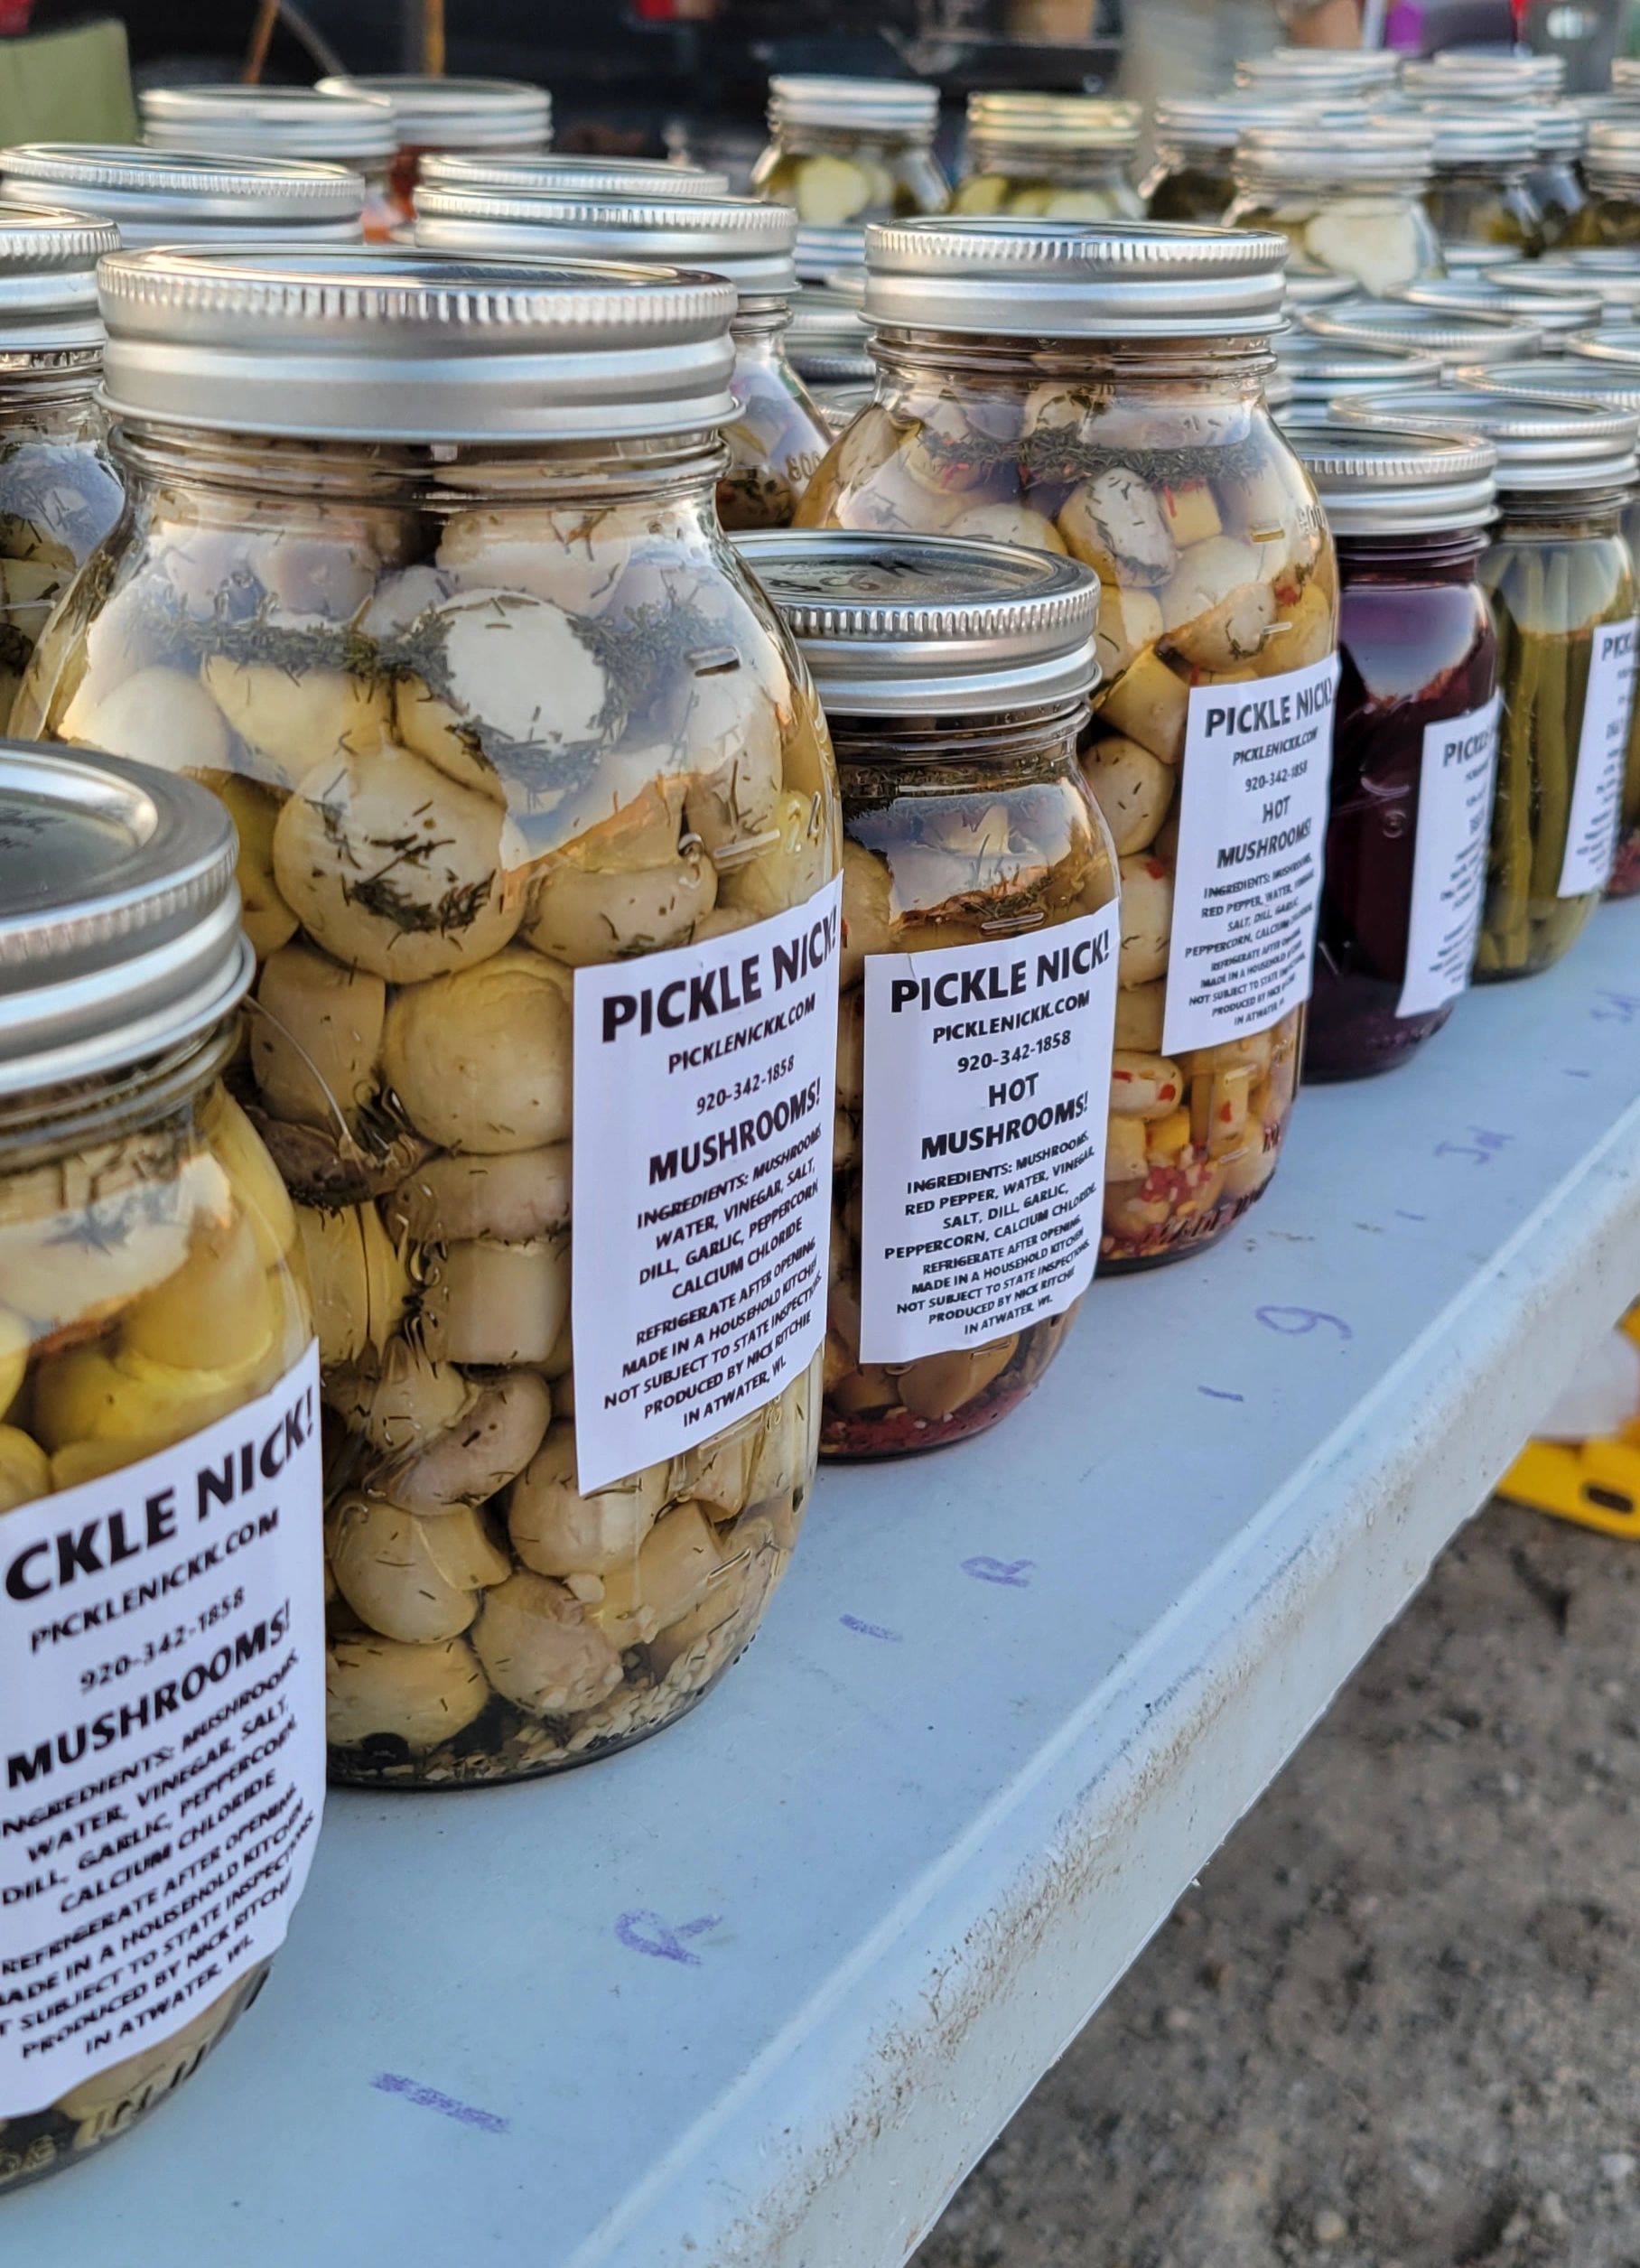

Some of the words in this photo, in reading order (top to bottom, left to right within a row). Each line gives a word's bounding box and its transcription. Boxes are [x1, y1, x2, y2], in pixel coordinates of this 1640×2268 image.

[1206, 695, 1291, 737] PICKLE
[1263, 795, 1291, 823] HOT
[1202, 906, 1224, 918] RED
[602, 955, 761, 1043] PICKLE
[772, 905, 836, 991] NICK!
[891, 961, 1026, 1013] PICKLE
[1037, 929, 1109, 987] NICK!
[1189, 994, 1210, 1005] NOT
[1213, 984, 1247, 1002] SUBJECT
[1249, 978, 1262, 990] TO
[1201, 975, 1225, 988] MADE
[1228, 971, 1238, 981] IN
[1240, 968, 1245, 978] A
[933, 990, 1089, 1043] PICKLENICKK.COM
[1212, 996, 1258, 1016] PRODUCED
[1235, 1015, 1244, 1025] IN
[669, 993, 815, 1074] PICKLENICKK.COM
[957, 1031, 1071, 1073] 920-342-1858
[697, 1055, 794, 1115] 920-342-1858
[989, 1072, 1039, 1107] HOT
[649, 1078, 820, 1185] MUSHROOMS!
[922, 1091, 1087, 1160] MUSHROOMS!
[638, 1173, 749, 1228] INGREDIENTS:
[657, 1215, 718, 1249] WATER,
[724, 1180, 783, 1222] VINEGAR,
[787, 1157, 815, 1186] SALT,
[905, 1200, 935, 1216] RED
[940, 1189, 998, 1209] PEPPER,
[1003, 1171, 1048, 1195] WATER,
[908, 1163, 1011, 1194] INGREDIENTS:
[943, 1212, 983, 1229] SALT,
[1023, 1183, 1068, 1208] GARLIC,
[640, 1259, 679, 1284] DILL,
[685, 1230, 744, 1265] GARLIC,
[672, 1256, 743, 1299] CALCIUM
[748, 1217, 802, 1265] CHLORIDE
[885, 1231, 989, 1259] PEPPERCORN,
[994, 1209, 1048, 1238] CALCIUM
[923, 1247, 1004, 1274] REFRIGERATE
[1007, 1235, 1038, 1255] AFTER
[637, 1293, 735, 1346] REFRIGERATE
[739, 1270, 771, 1303] AFTER
[774, 1237, 815, 1277] OPENING
[897, 1300, 926, 1314] NOT
[929, 1288, 983, 1308] SUBJECT
[985, 1283, 1001, 1295] TO
[1003, 1269, 1035, 1290] STATE
[912, 1277, 950, 1294] MADE
[955, 1274, 968, 1285] IN
[971, 1272, 980, 1282] A
[983, 1248, 1048, 1279] HOUSEHOLD
[929, 1301, 994, 1324] PRODUCED
[998, 1293, 1011, 1307] BY
[1015, 1283, 1039, 1301] NICK
[964, 1323, 978, 1334] IN
[622, 1346, 667, 1377] MADE
[673, 1338, 689, 1357] IN
[694, 1333, 704, 1348] A
[709, 1288, 780, 1341] HOUSEHOLD
[604, 1384, 639, 1409] NOT
[644, 1354, 708, 1394] SUBJECT
[712, 1345, 730, 1363] TO
[733, 1321, 769, 1353] STATE
[645, 1372, 723, 1419] PRODUCED
[727, 1359, 743, 1380] BY
[747, 1340, 773, 1368] NICK
[775, 1310, 811, 1349] RITCHIE
[684, 1408, 700, 1427] IN
[704, 1371, 769, 1417] ATWATER,
[197, 1387, 312, 1522] NICK!
[80, 1587, 243, 1693] 920-342-1858
[7, 1601, 288, 1788] MUSHROOMS!
[0, 1748, 172, 1837] NGREDIENTS:
[61, 1843, 172, 1913] CALCIUM
[178, 1769, 274, 1850] CHLORIDE
[164, 1843, 227, 1896] AFTER
[21, 1969, 121, 2030] SUBJECT
[128, 1950, 158, 1974] TO
[164, 1904, 219, 1955] STATE
[23, 1983, 147, 2058] PRODUCED
[155, 1961, 180, 1988] BY
[188, 1918, 236, 1967] NICK
[66, 1955, 91, 1981] IN
[100, 1945, 115, 1963] A
[87, 2030, 111, 2054] IN
